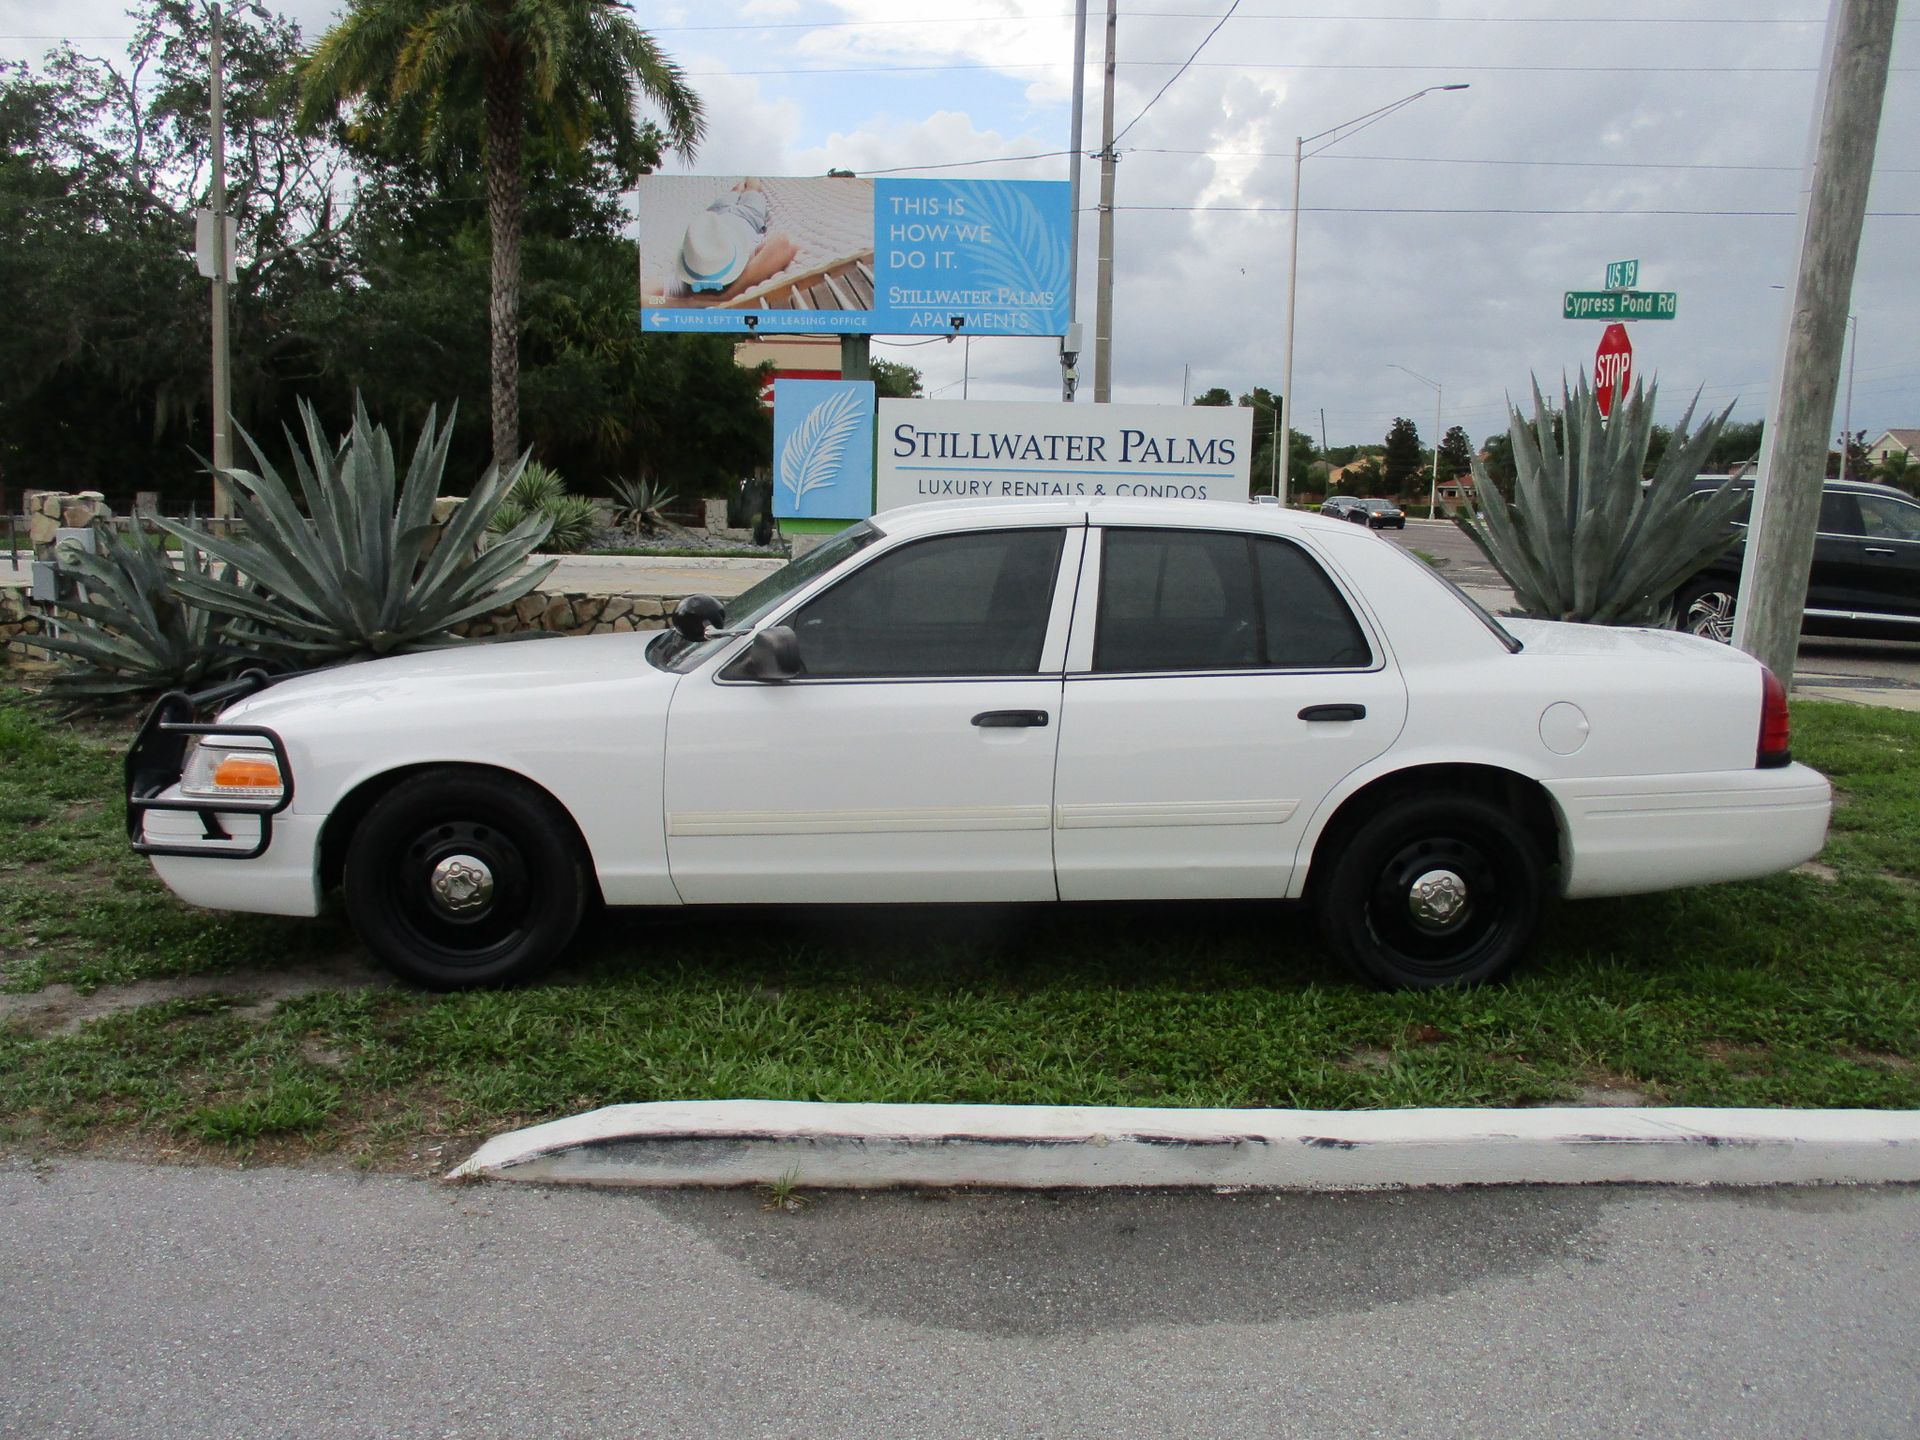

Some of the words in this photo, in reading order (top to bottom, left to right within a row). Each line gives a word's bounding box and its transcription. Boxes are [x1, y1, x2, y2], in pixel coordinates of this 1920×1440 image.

[889, 197, 939, 216] THIS
[948, 198, 966, 216] IS
[890, 224, 949, 242] HOW
[955, 225, 993, 243] WE
[890, 251, 926, 269] DO
[935, 251, 958, 270] IT.
[1608, 264, 1621, 289] US
[1625, 261, 1635, 287] 19
[889, 286, 993, 305] STILLWATER
[997, 286, 1055, 305] PALMS
[1565, 293, 1615, 317] Cypress
[1620, 294, 1653, 313] Pond
[1657, 294, 1676, 313] Rd
[673, 314, 704, 325] TURN
[707, 315, 732, 325] LEFT
[781, 316, 827, 326] LEASING
[830, 316, 868, 326] OFFICE
[1596, 352, 1630, 388] STOP
[893, 424, 1106, 463] STILLWATER
[1117, 429, 1236, 466] PALMS
[918, 479, 993, 496] LUXURY
[1094, 483, 1107, 497] &
